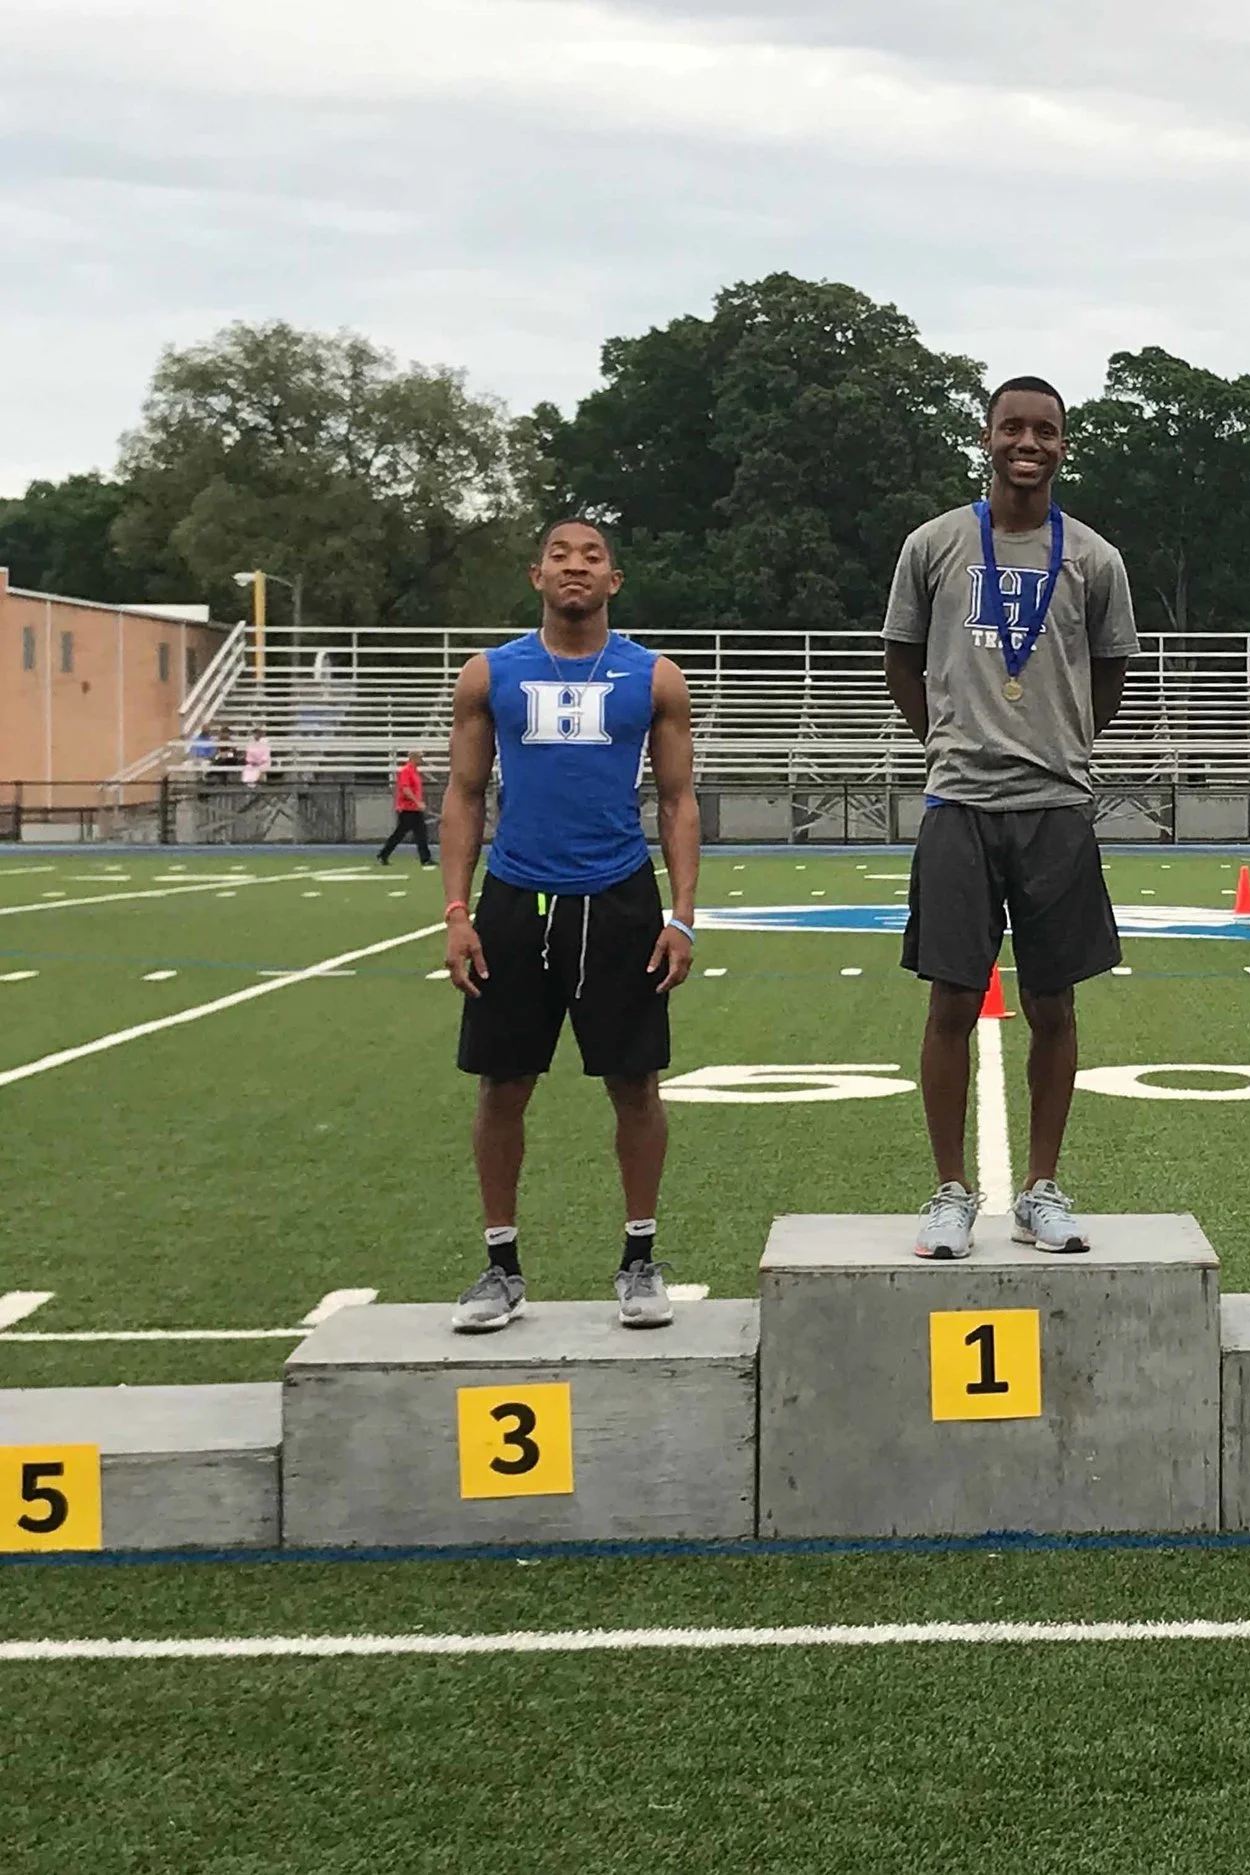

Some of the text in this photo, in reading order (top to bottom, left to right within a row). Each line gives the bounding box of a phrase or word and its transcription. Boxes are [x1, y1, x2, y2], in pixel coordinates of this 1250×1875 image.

[966, 564, 1049, 633] H
[971, 630, 1037, 651] TRC
[520, 681, 615, 745] H
[964, 1324, 1009, 1396] 1
[488, 1402, 541, 1475] 3
[17, 1462, 69, 1534] 5
